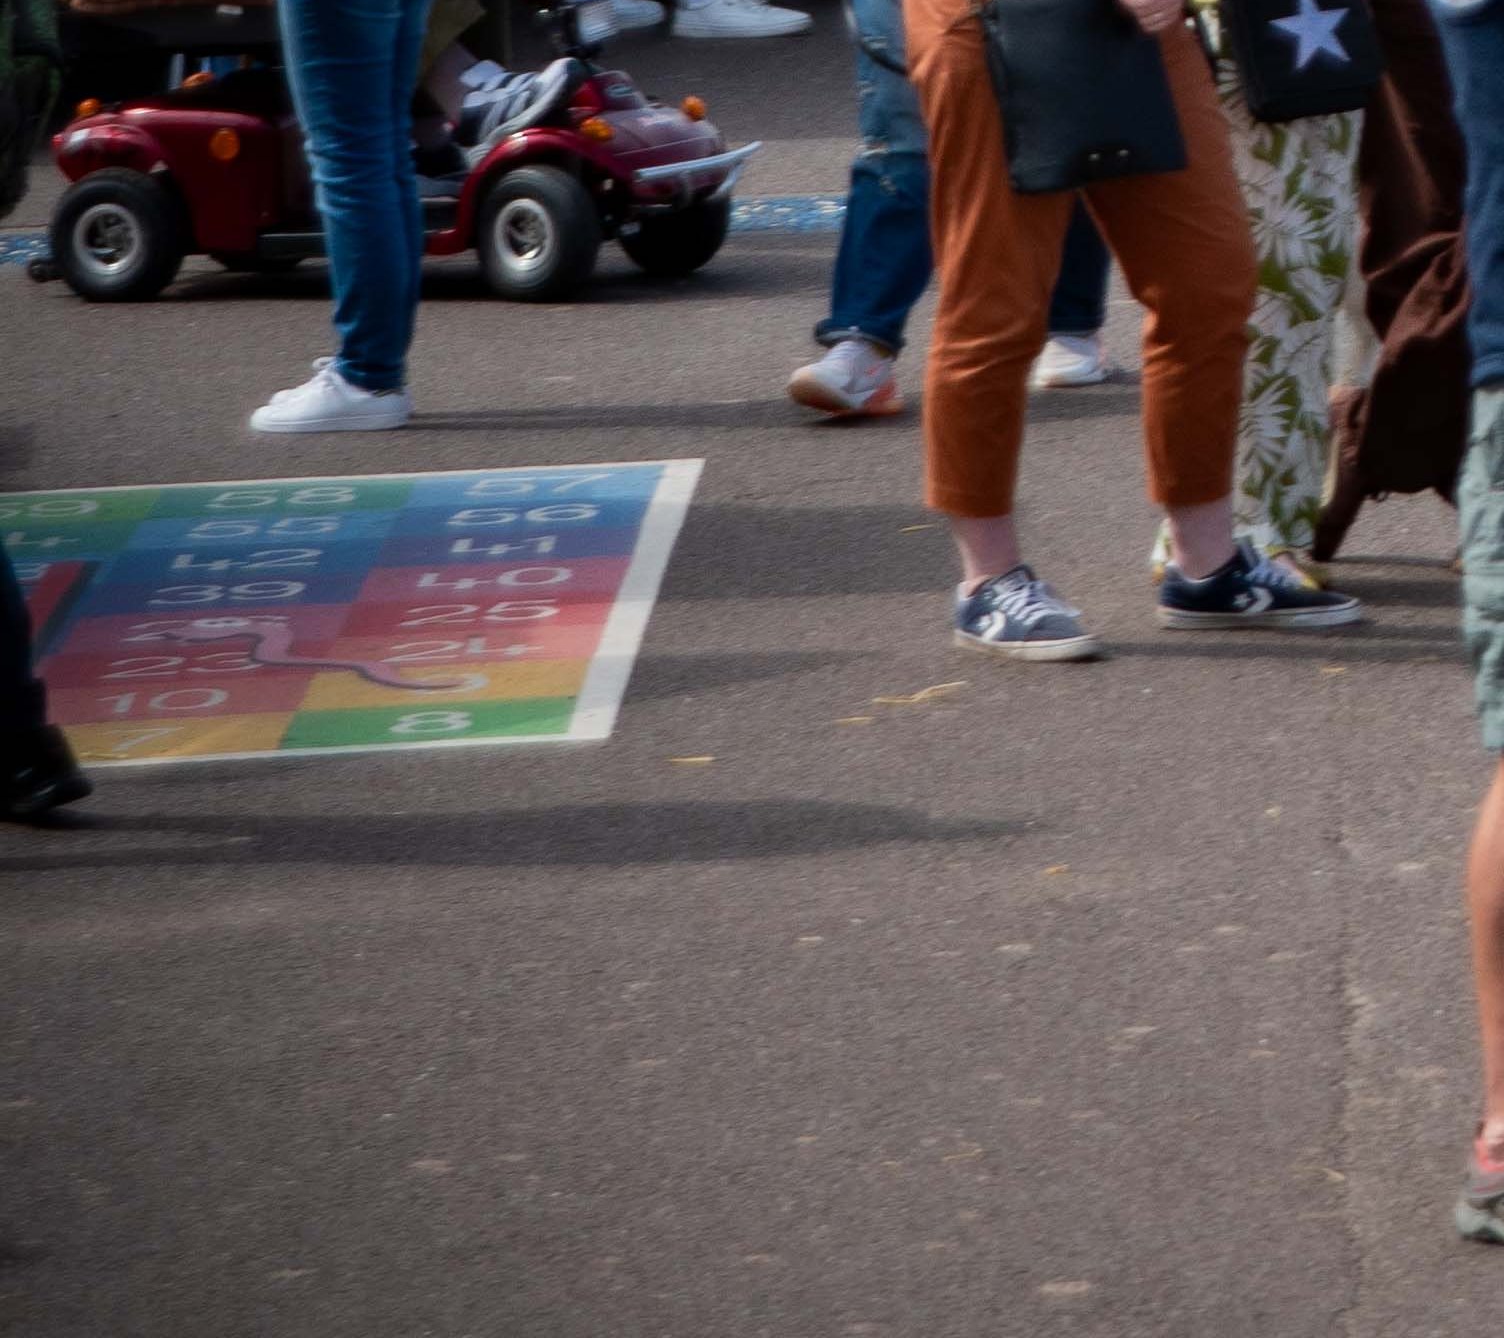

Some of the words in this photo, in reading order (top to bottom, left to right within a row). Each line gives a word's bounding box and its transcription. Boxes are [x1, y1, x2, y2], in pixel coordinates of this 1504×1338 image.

[463, 472, 613, 497] 57
[206, 486, 358, 509] 58
[447, 503, 599, 526] 56
[185, 520, 343, 540] 55
[451, 534, 560, 555] 41
[171, 548, 324, 571] 42
[416, 566, 574, 590] 40
[148, 580, 307, 604] 39
[402, 598, 561, 626] 25
[379, 635, 546, 662] 24
[100, 653, 266, 679] 23
[97, 687, 230, 714] 10
[388, 709, 475, 734] 8
[104, 726, 188, 752] 7
